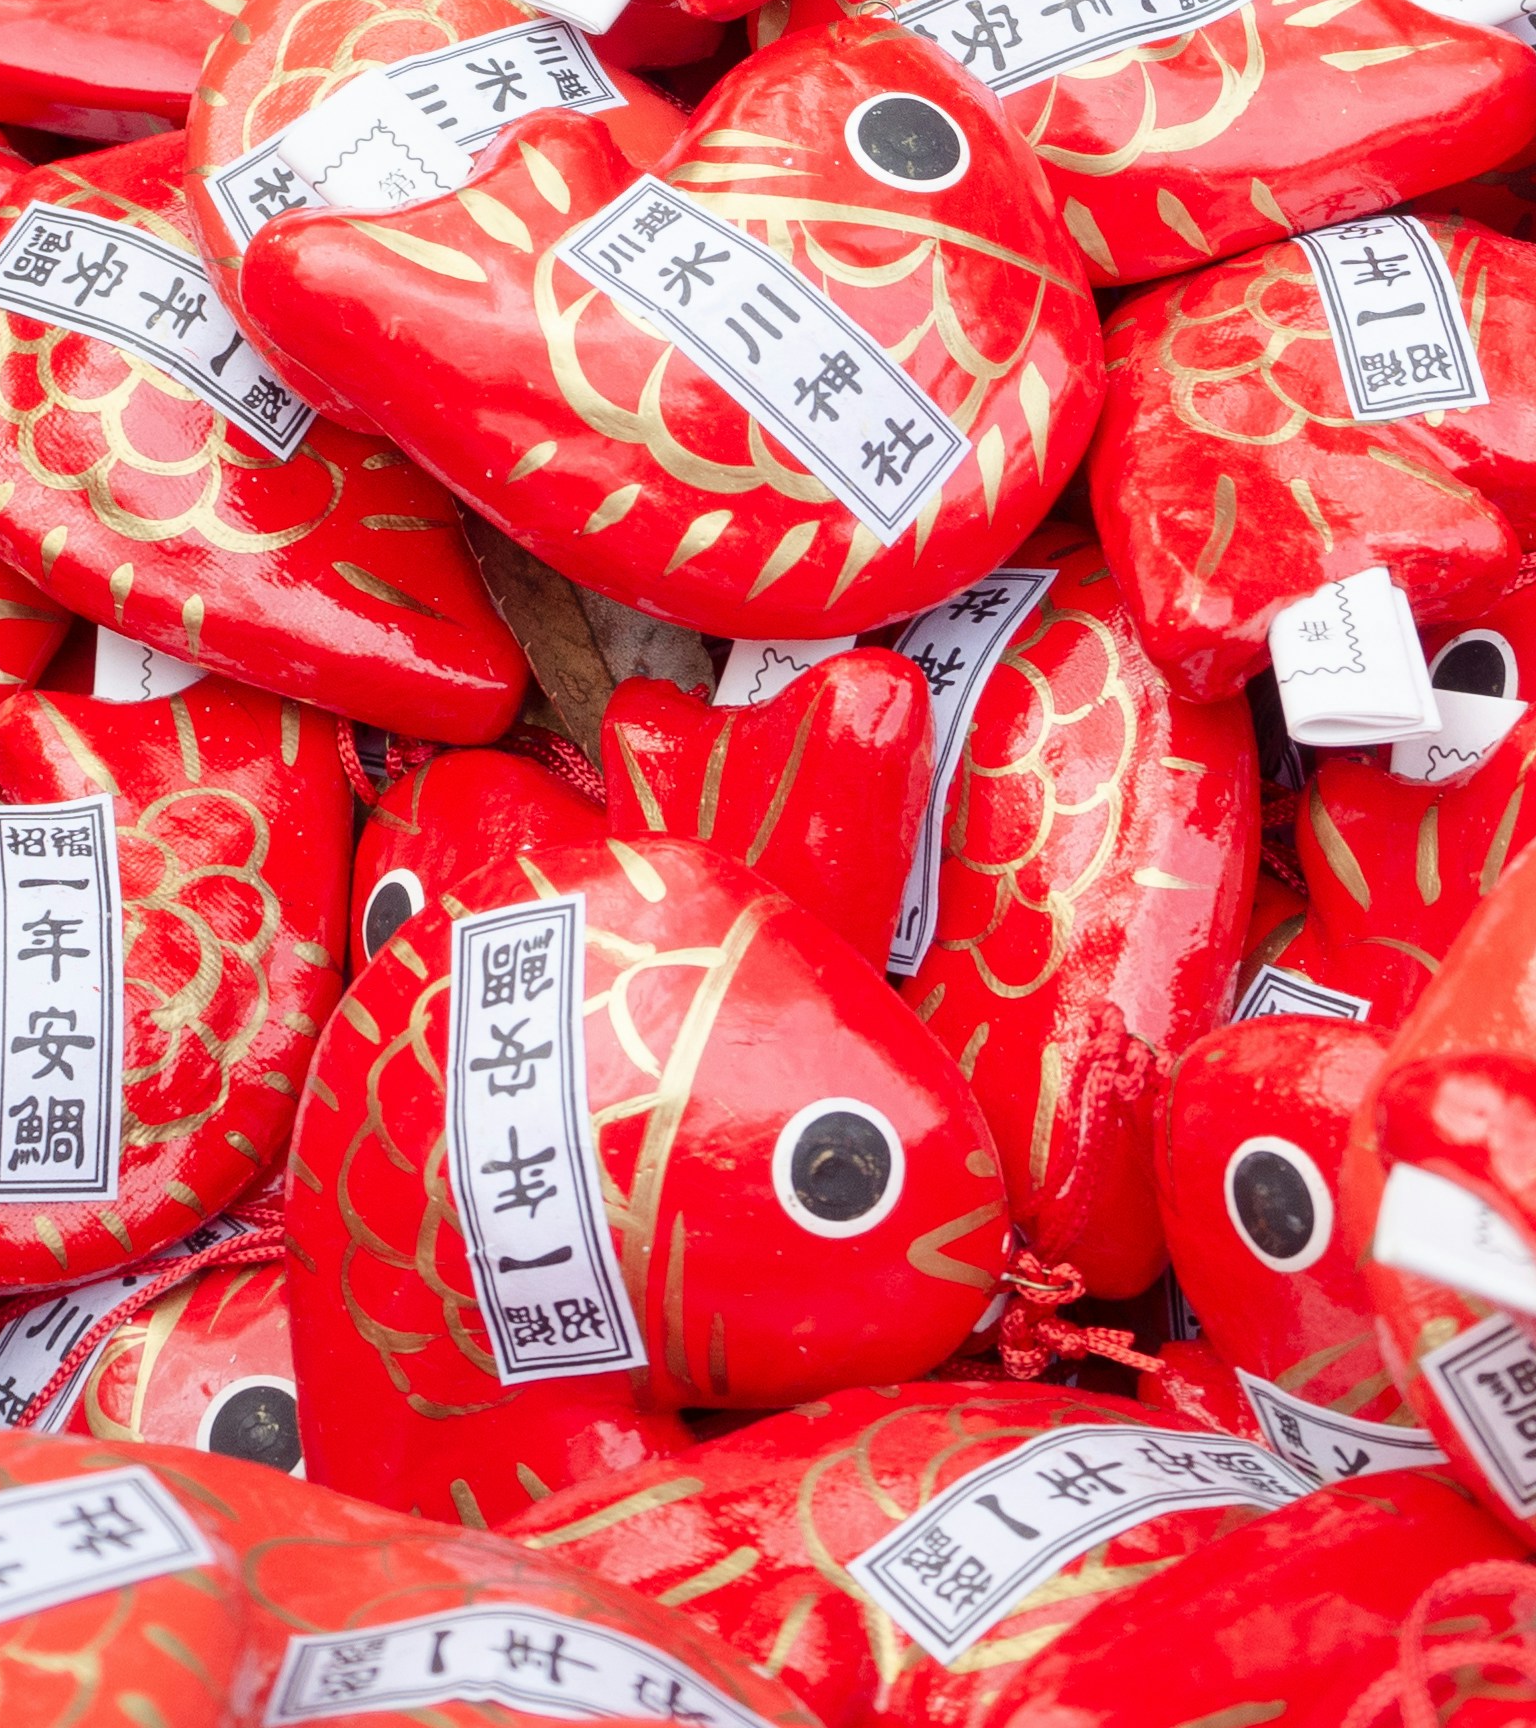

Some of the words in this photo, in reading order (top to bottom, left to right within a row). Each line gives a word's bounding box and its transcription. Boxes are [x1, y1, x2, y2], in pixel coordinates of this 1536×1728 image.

[528, 33, 590, 102] 川越
[597, 199, 683, 276] 川越
[3, 224, 246, 379] 一年安鯛
[657, 240, 936, 489] 氷川神社
[1360, 343, 1455, 393] 招福
[5, 825, 93, 860] 招福
[7, 877, 98, 1171] 一年安鯛
[469, 926, 576, 1275] 一年安鯛
[503, 1295, 608, 1350] 招福
[974, 1437, 1297, 1544] 一年安鯛
[900, 1528, 999, 1614] 招福
